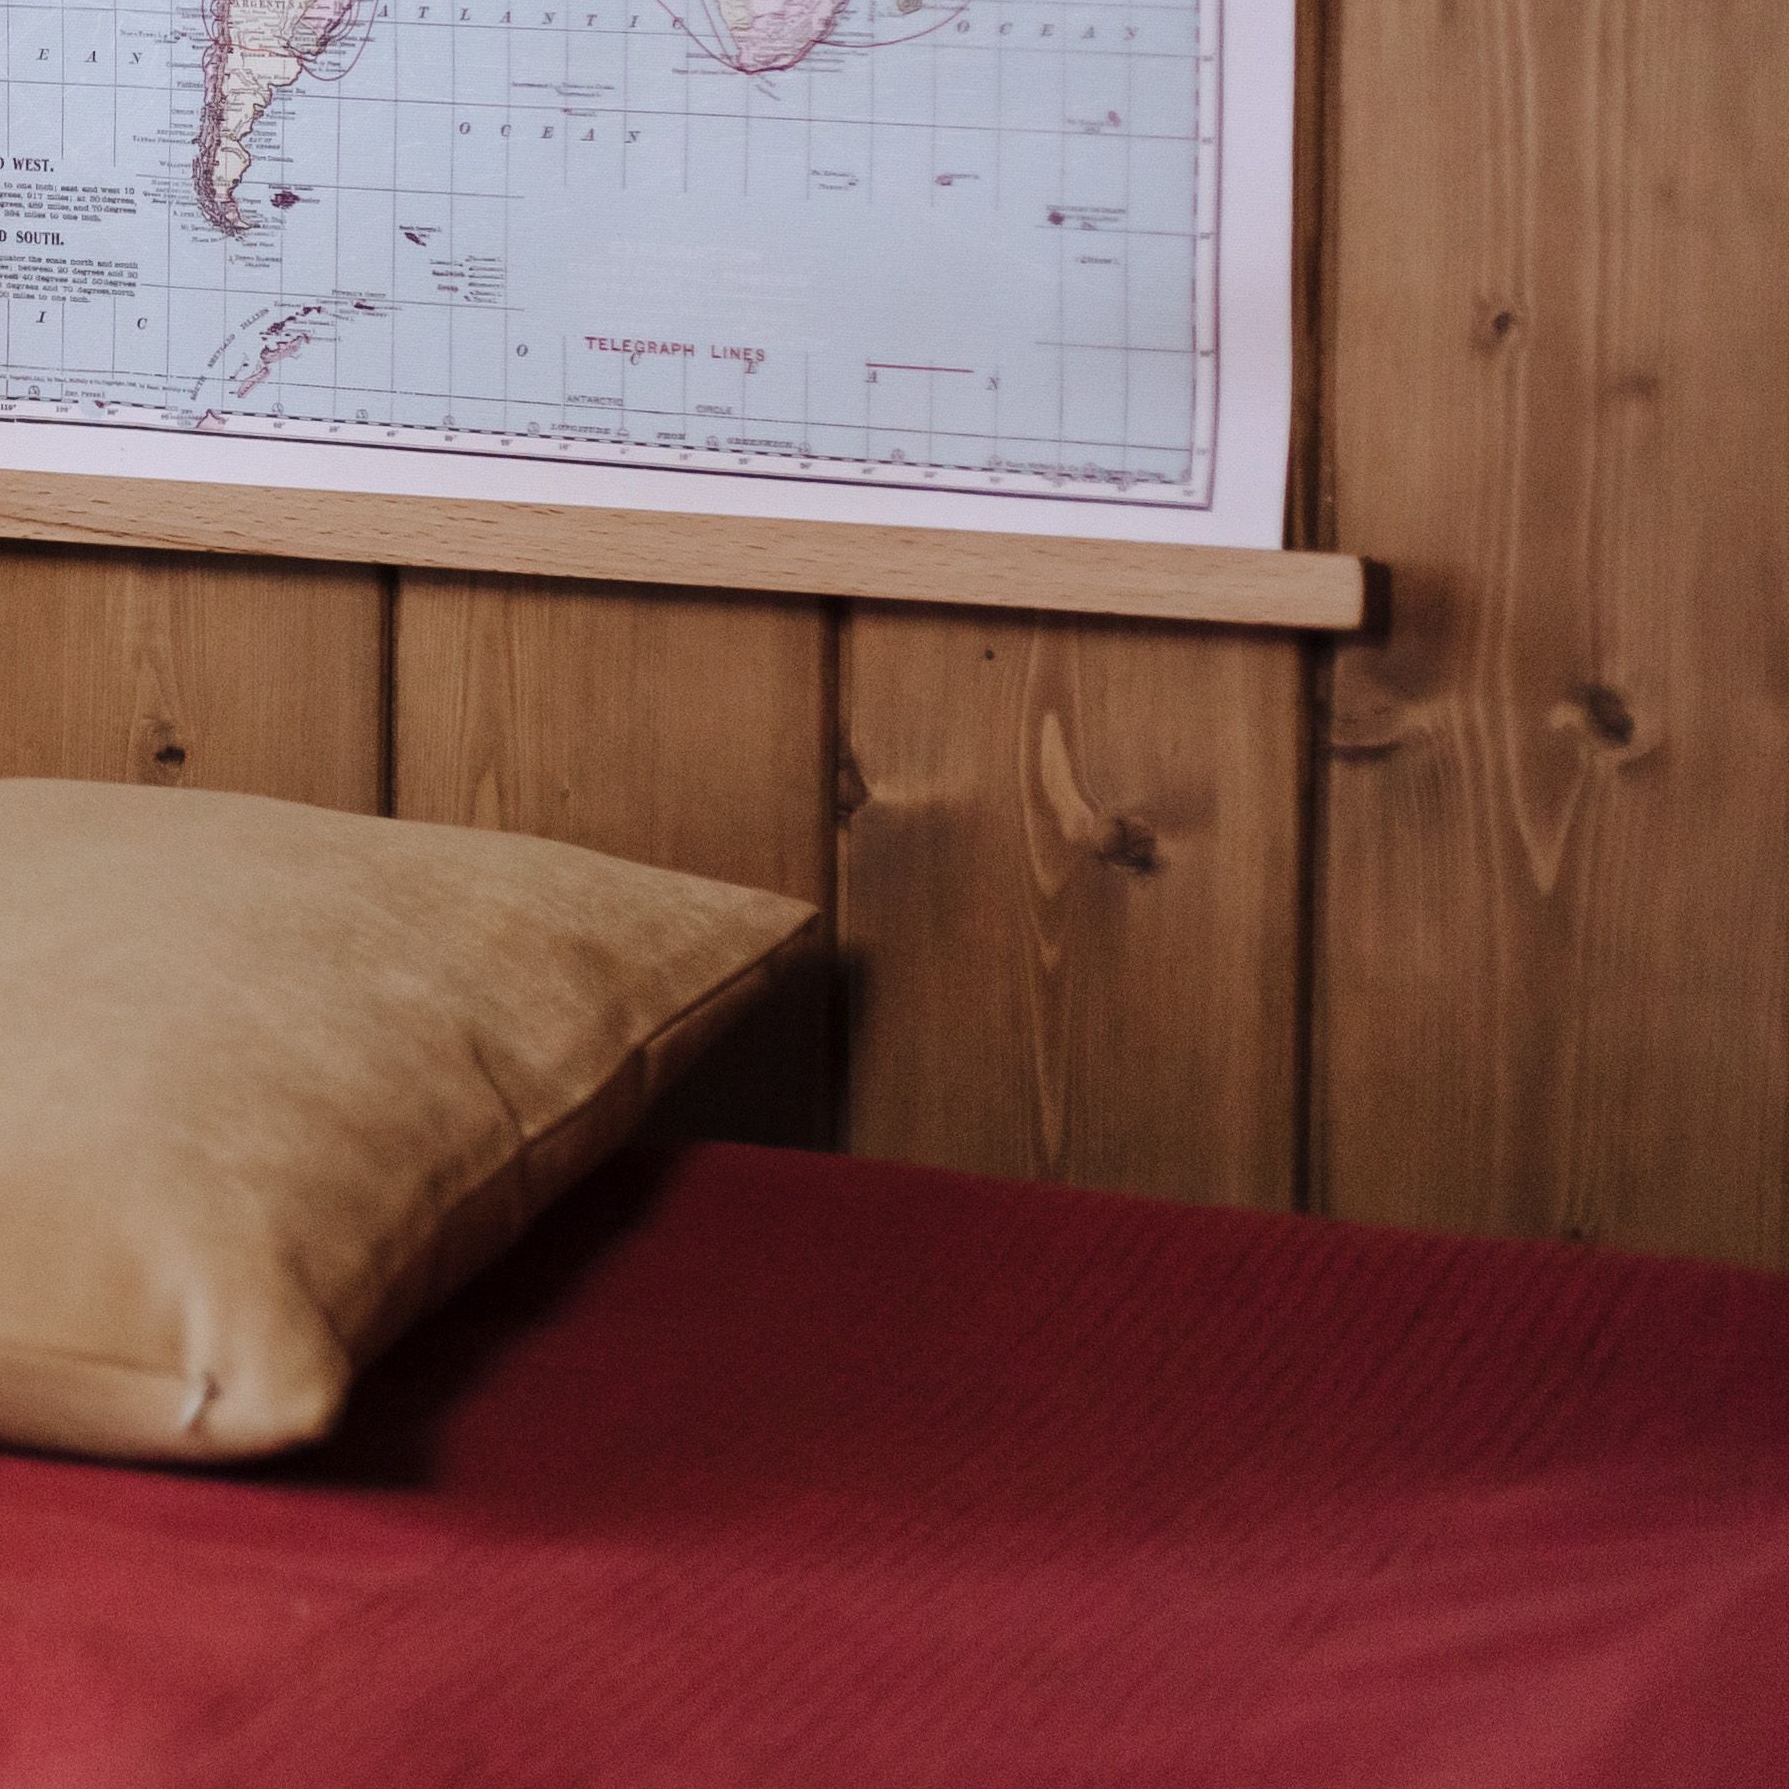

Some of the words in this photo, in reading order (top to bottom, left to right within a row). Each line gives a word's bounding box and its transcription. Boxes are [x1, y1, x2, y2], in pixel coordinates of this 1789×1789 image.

[458, 122, 642, 144] OCEAN
[13, 157, 54, 172] WEST.
[4, 181, 13, 189] to
[82, 185, 98, 194] and
[16, 230, 65, 246] SOUTH.
[29, 254, 42, 263] the
[71, 256, 93, 266] north
[97, 257, 113, 267] and
[584, 336, 695, 359] TELEGRAPH
[710, 344, 766, 364] LINES
